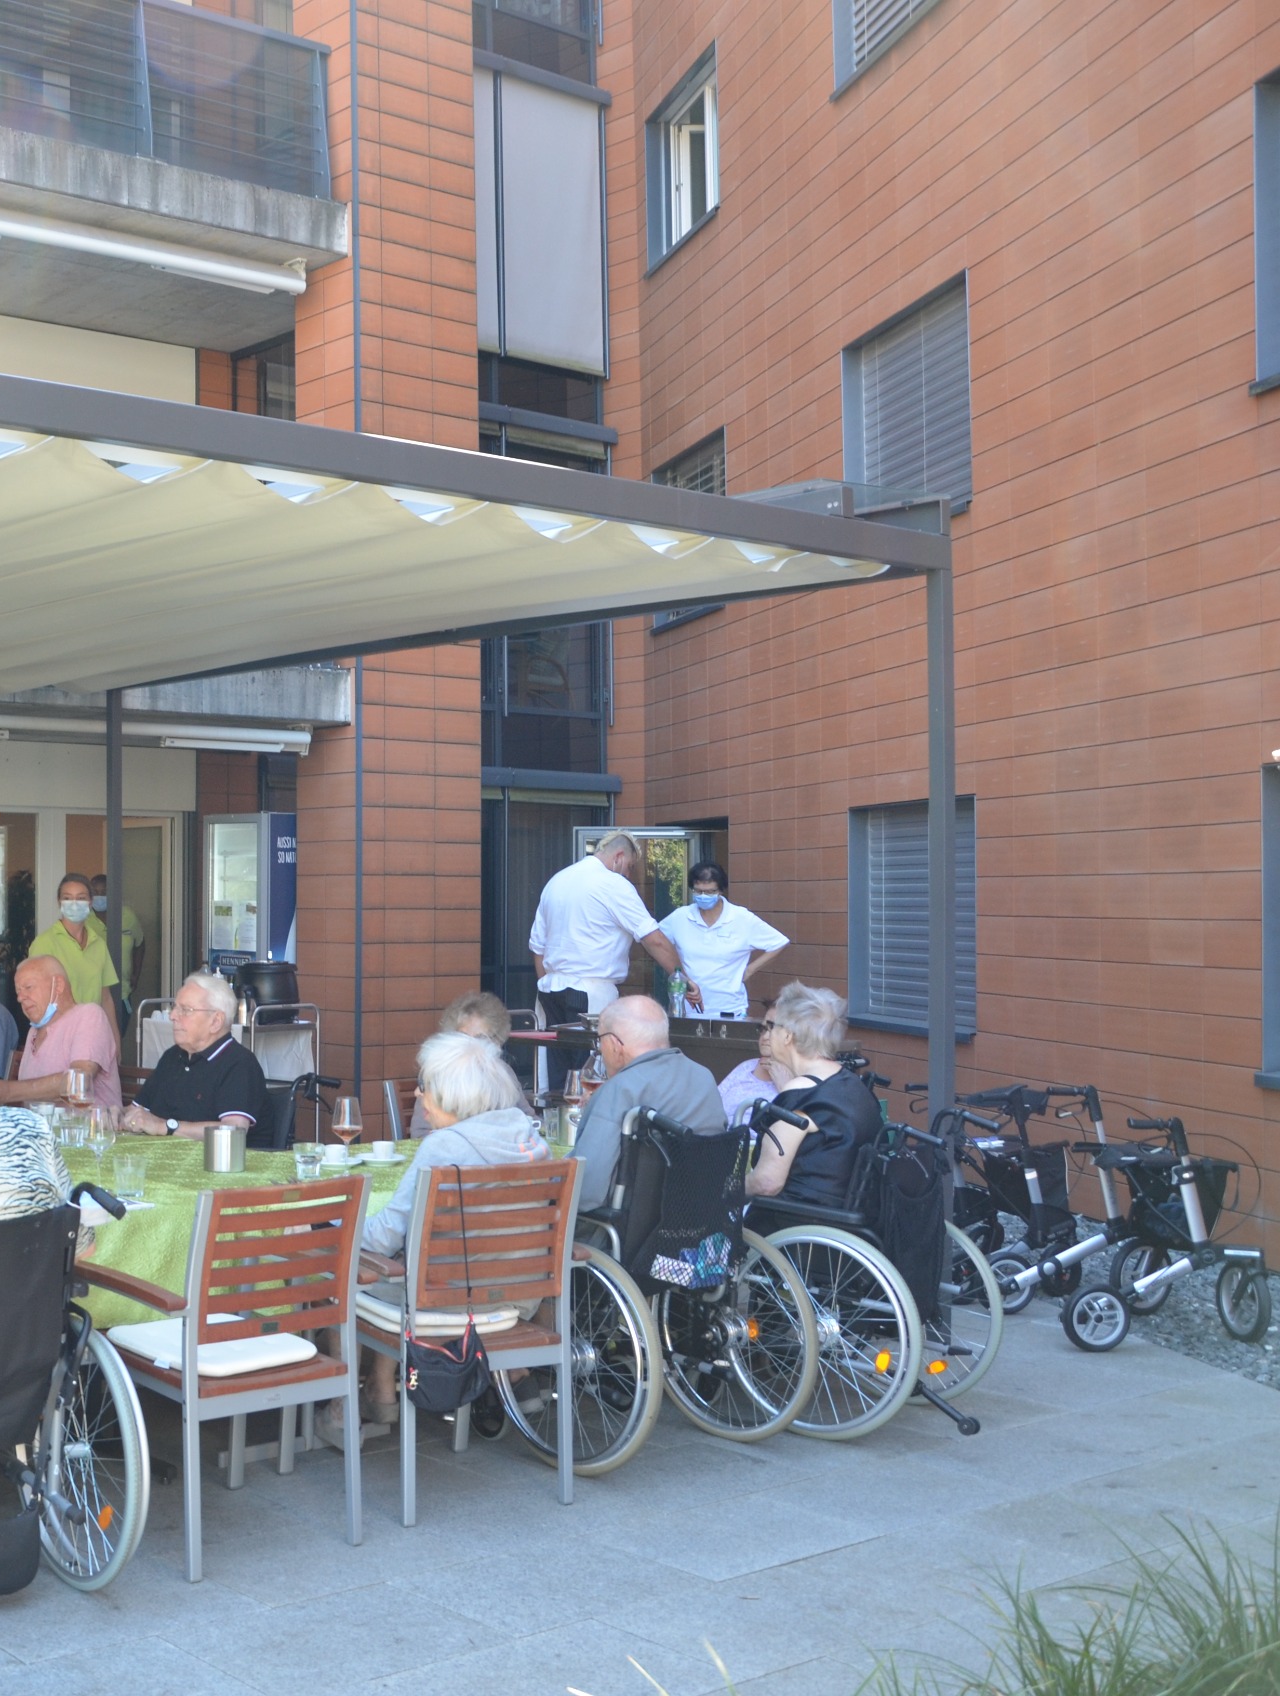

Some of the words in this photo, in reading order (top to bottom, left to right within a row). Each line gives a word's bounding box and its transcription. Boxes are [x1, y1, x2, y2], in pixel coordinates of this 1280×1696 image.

[277, 836, 291, 848] AUSSI
[277, 851, 285, 864] SO
[286, 851, 297, 864] NAT
